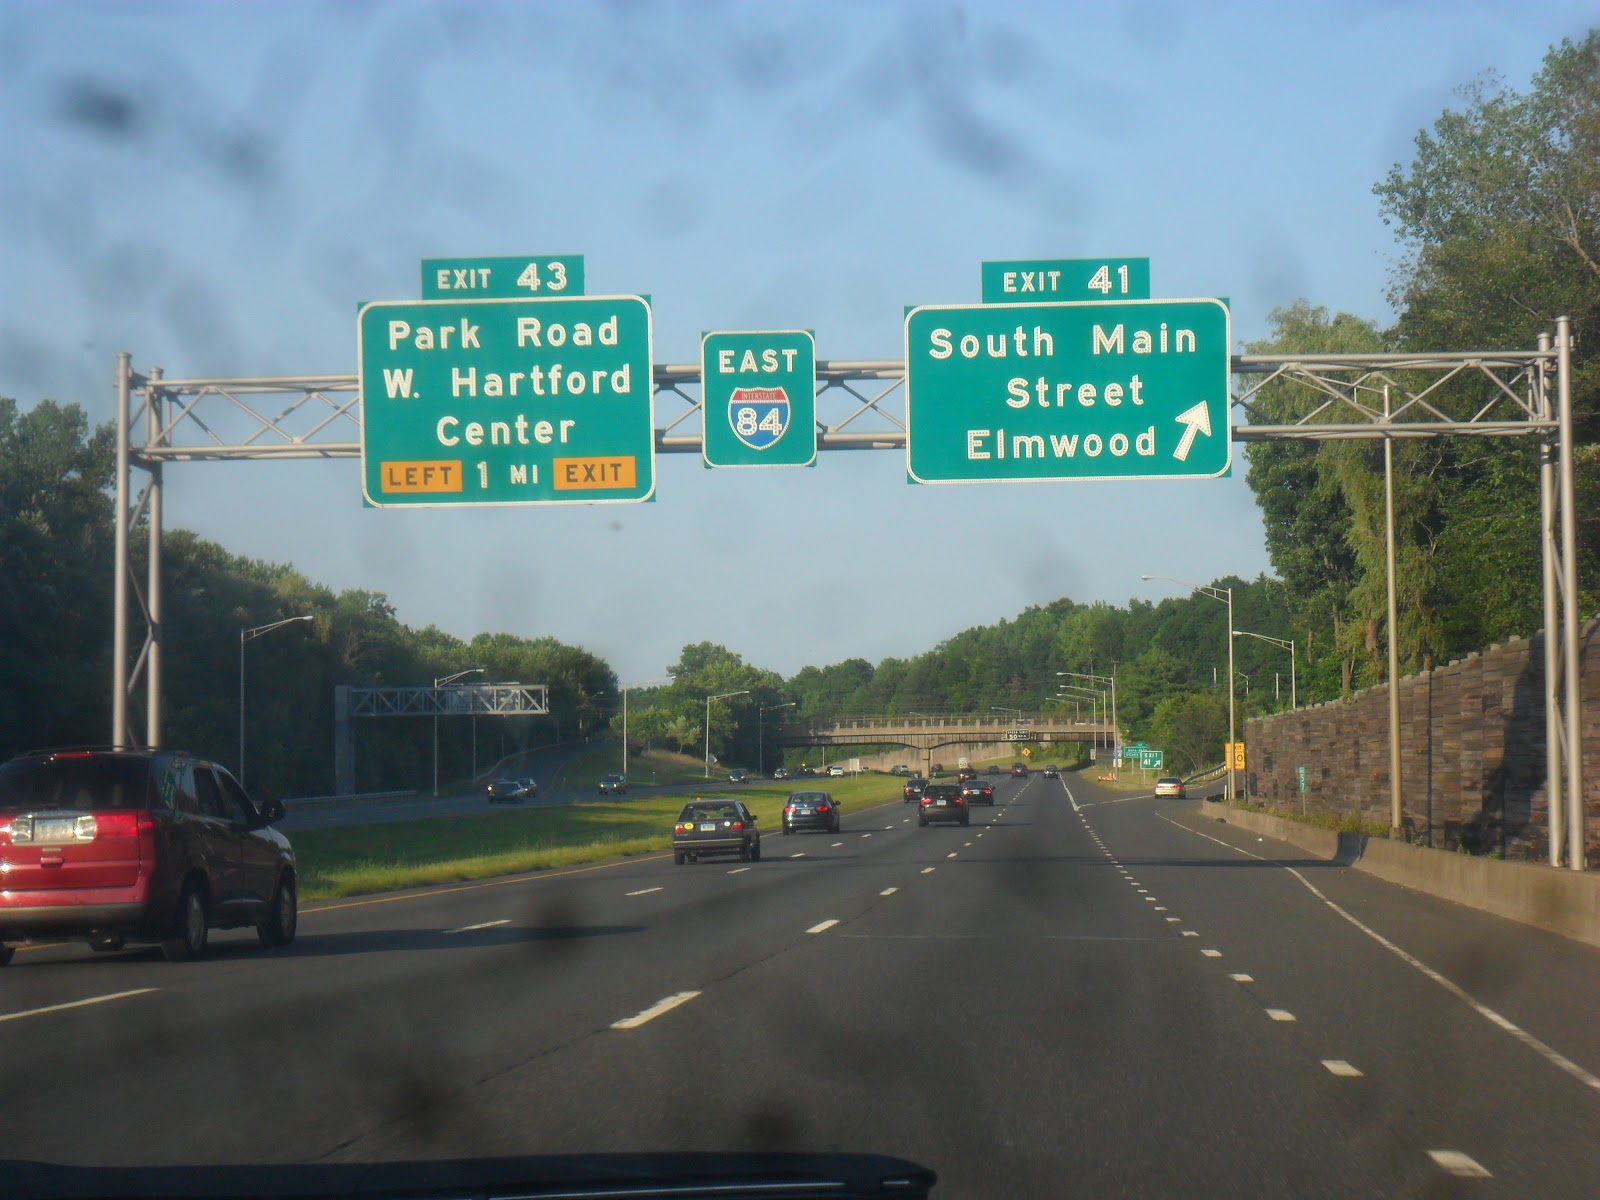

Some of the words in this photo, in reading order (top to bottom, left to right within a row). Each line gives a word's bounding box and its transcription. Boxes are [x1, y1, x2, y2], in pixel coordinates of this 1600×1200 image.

[437, 269, 491, 290] EXIT
[516, 262, 568, 292] 43
[1003, 271, 1061, 293] EXIT
[1087, 264, 1129, 294] 41
[388, 318, 481, 351] Park
[517, 315, 618, 348] Road
[928, 325, 1054, 360] South
[1092, 322, 1196, 355] Main
[718, 348, 798, 374] EAST
[382, 368, 420, 399] W.
[451, 363, 631, 398] Hartford
[741, 392, 776, 400] INTERSTATE
[1005, 374, 1144, 409] Street
[436, 414, 576, 447] Center
[736, 407, 783, 436] 84
[967, 425, 1155, 460] Elmwood
[388, 466, 453, 487] LEFT
[476, 461, 489, 489] 1
[510, 464, 539, 485] MI
[565, 462, 623, 484] EXIT
